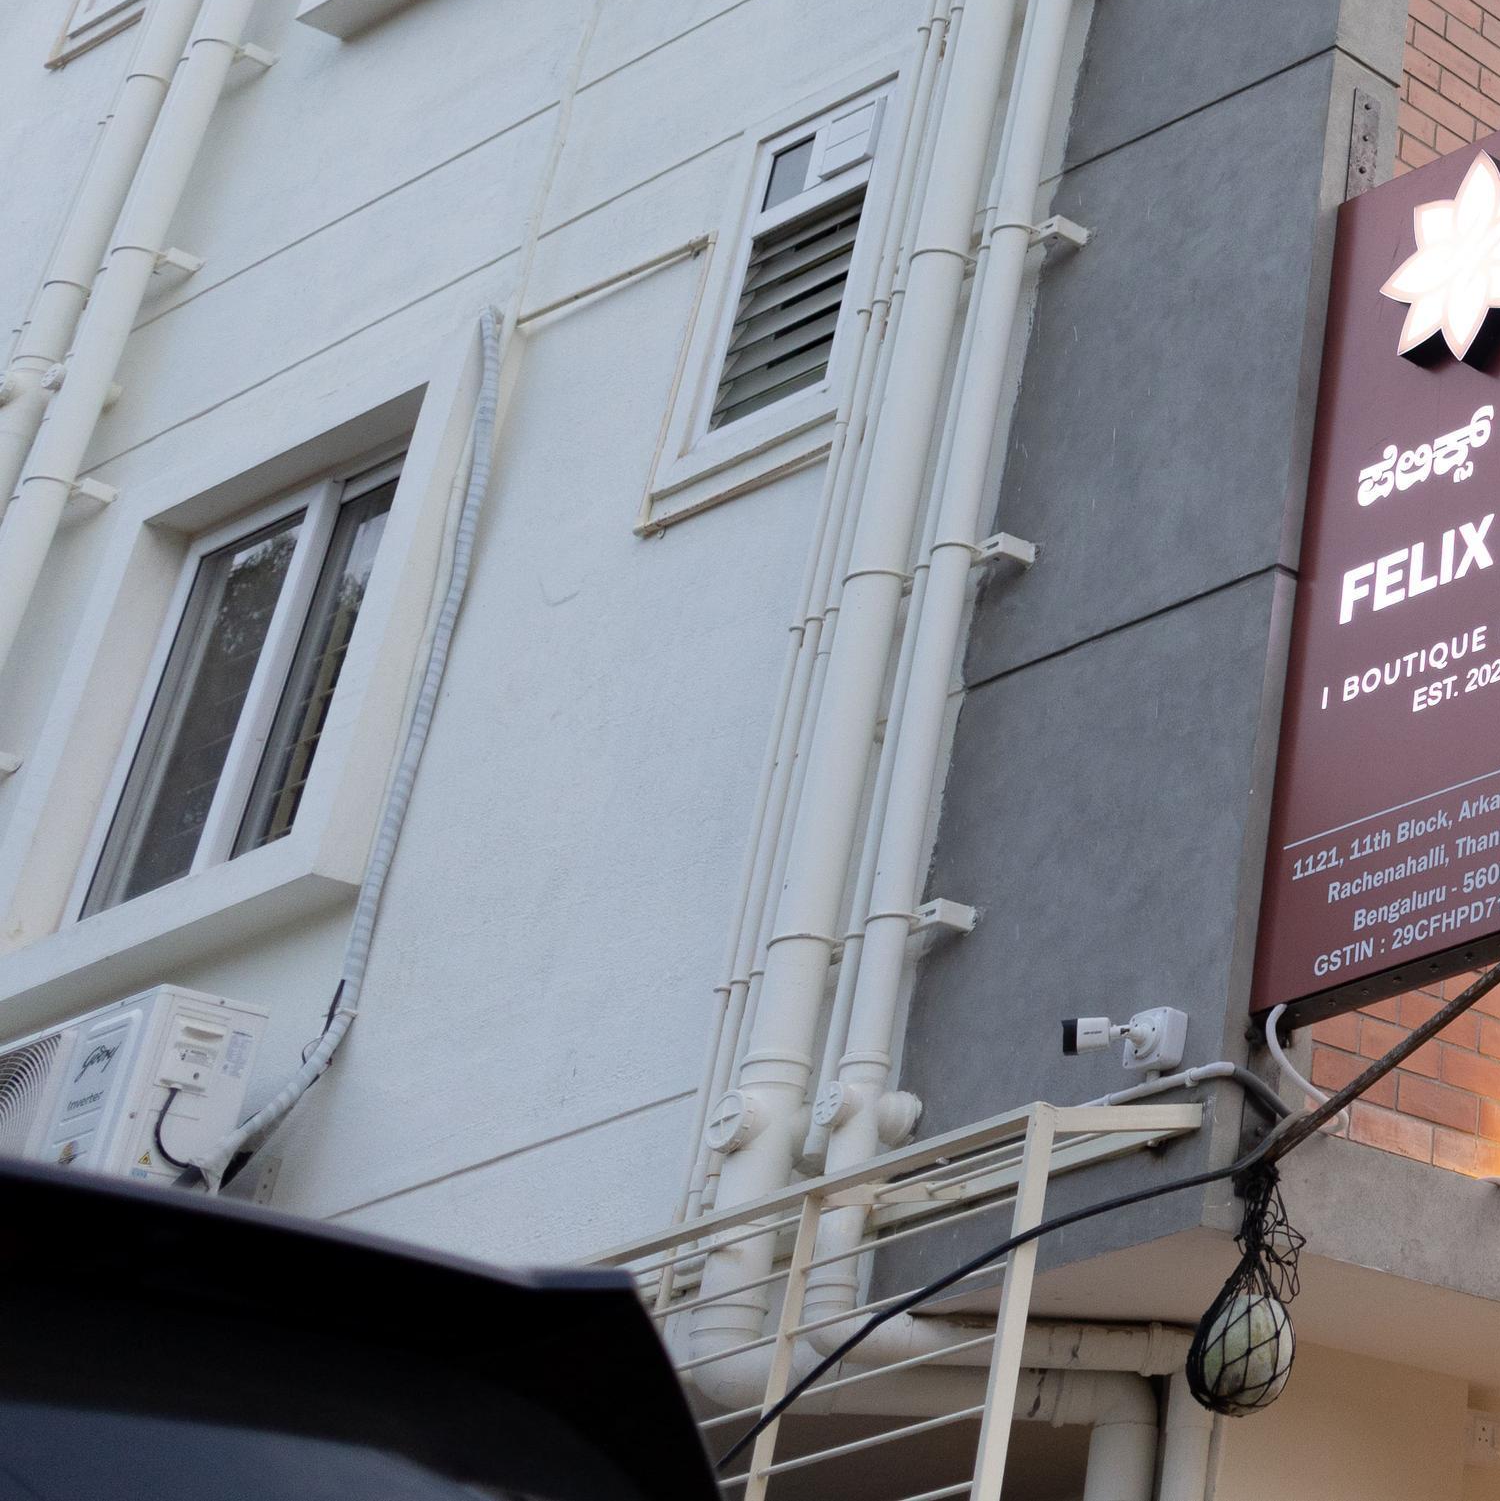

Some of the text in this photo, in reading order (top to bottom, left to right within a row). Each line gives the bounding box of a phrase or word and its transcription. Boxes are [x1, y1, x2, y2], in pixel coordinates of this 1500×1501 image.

[1339, 513, 1495, 625] FELIX
[1342, 625, 1488, 702] BOUTIQUE
[1412, 675, 1459, 713] EST.
[1292, 846, 1344, 881] 1121,
[1349, 828, 1391, 861] 11th
[1396, 809, 1453, 844] Block,
[1327, 844, 1449, 903] Rachenahalli,
[1353, 880, 1446, 932] Bengaluru
[1313, 937, 1374, 977] GSTIN
